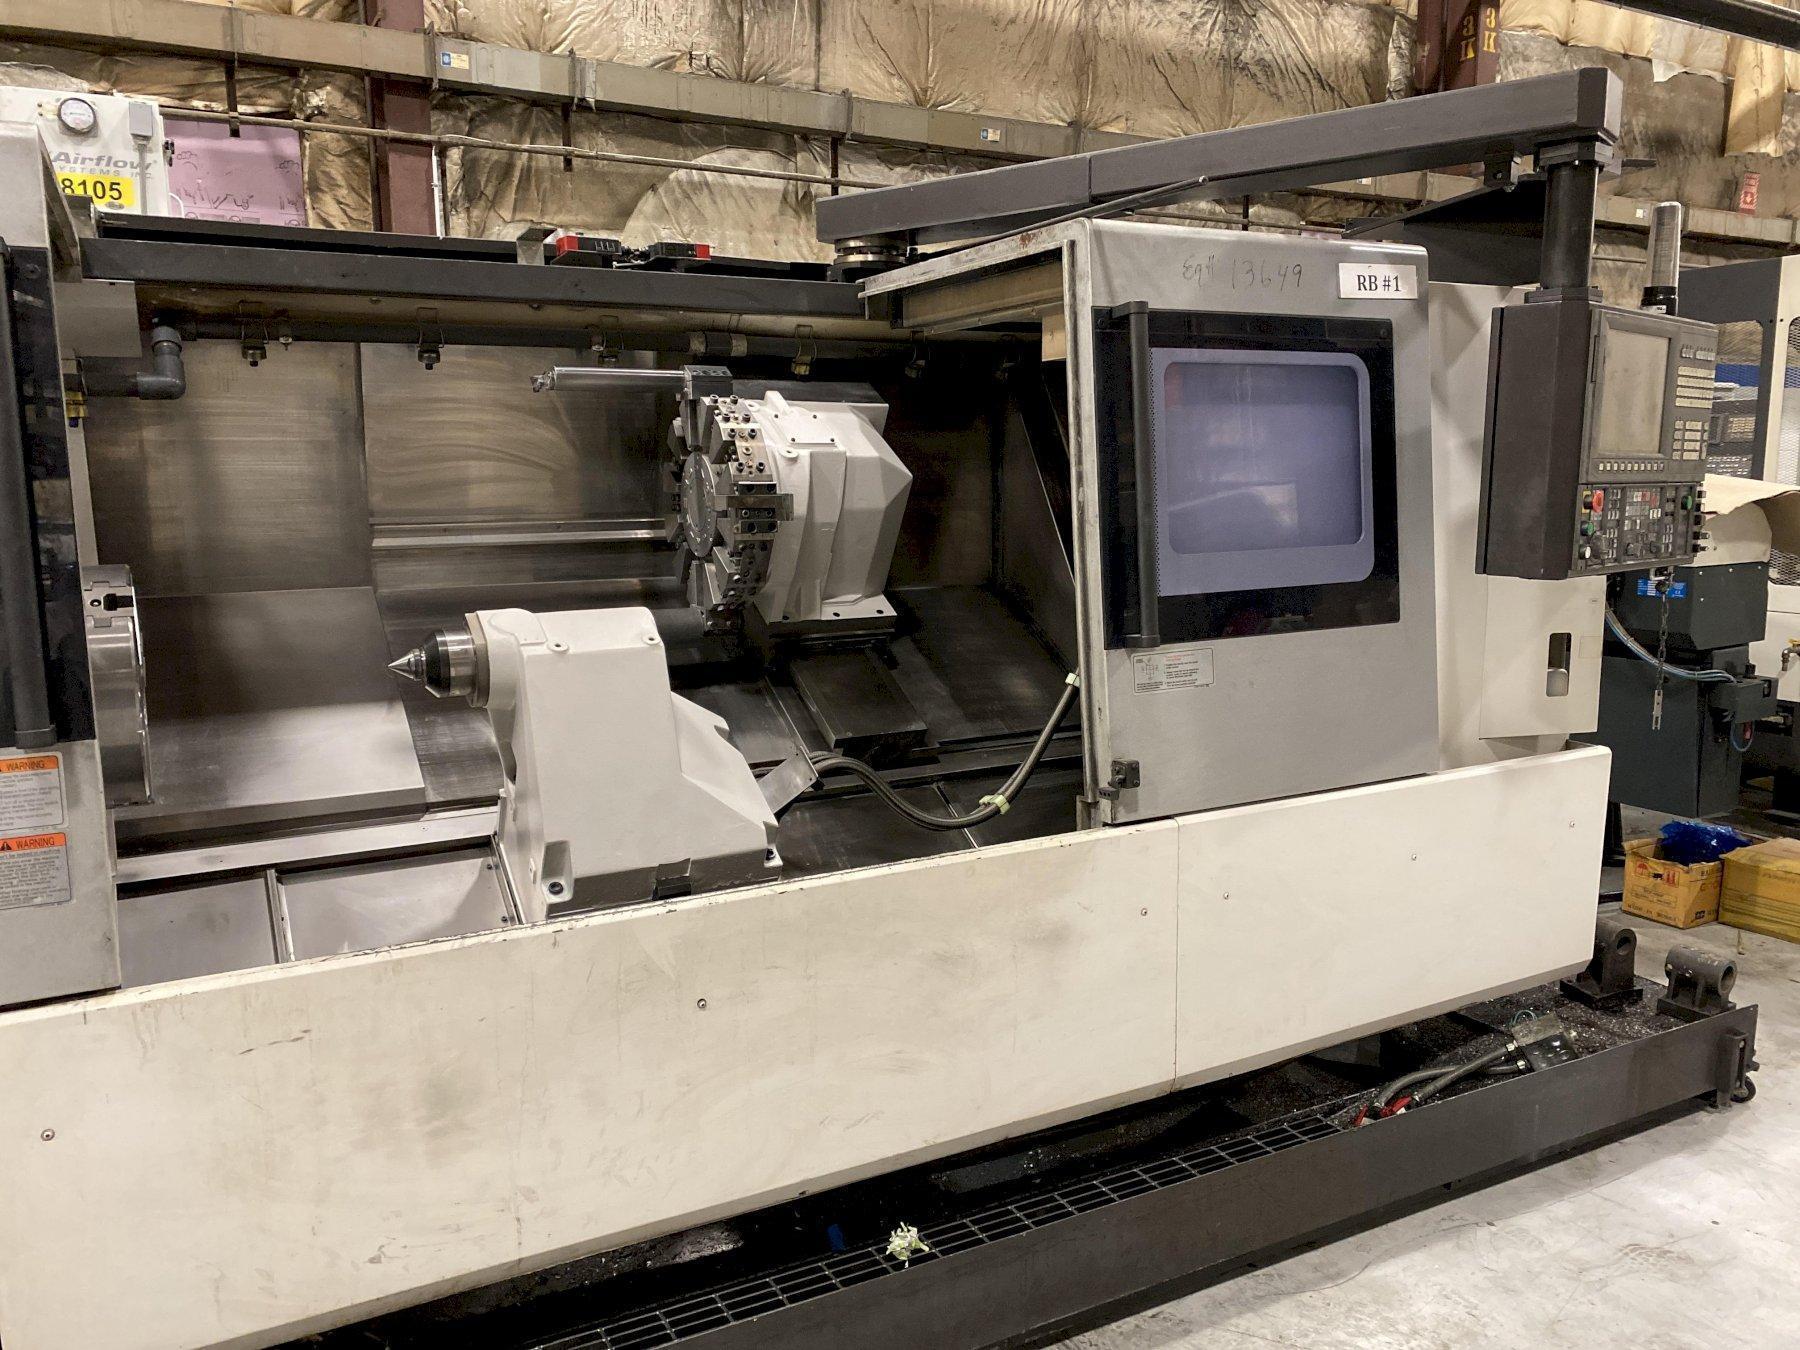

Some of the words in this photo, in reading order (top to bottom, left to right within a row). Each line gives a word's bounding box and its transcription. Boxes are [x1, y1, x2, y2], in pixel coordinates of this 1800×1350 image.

[52, 151, 152, 171] Airflow
[59, 165, 121, 177] YSTEMS
[61, 178, 122, 200] 8105
[1357, 274, 1378, 291] RB
[1382, 276, 1402, 292] #1
[7, 760, 45, 771] WARNING
[16, 837, 55, 849] WARNING
